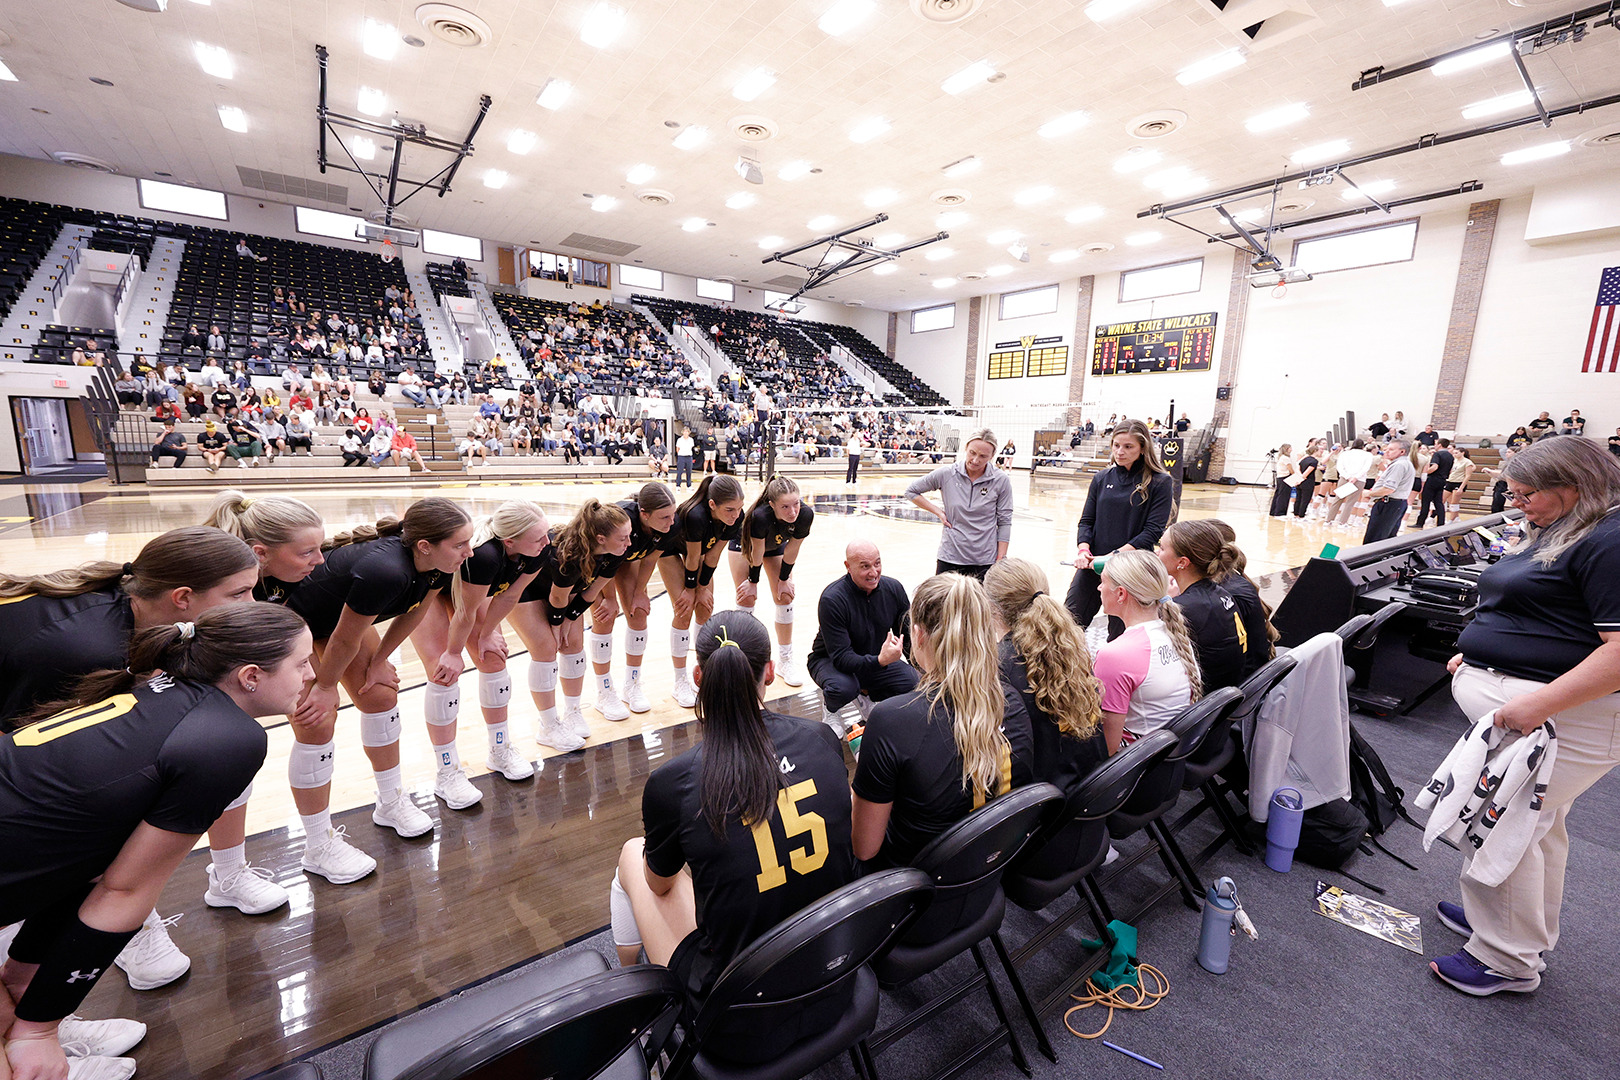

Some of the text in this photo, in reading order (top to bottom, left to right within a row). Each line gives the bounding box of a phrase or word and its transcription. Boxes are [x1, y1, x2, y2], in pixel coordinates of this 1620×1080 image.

[1108, 314, 1211, 335] WAYNE STATE WILDCATS
[1020, 335, 1037, 348] W
[1168, 347, 1178, 356] 17
[1164, 460, 1176, 468] W
[741, 778, 829, 893] 15
